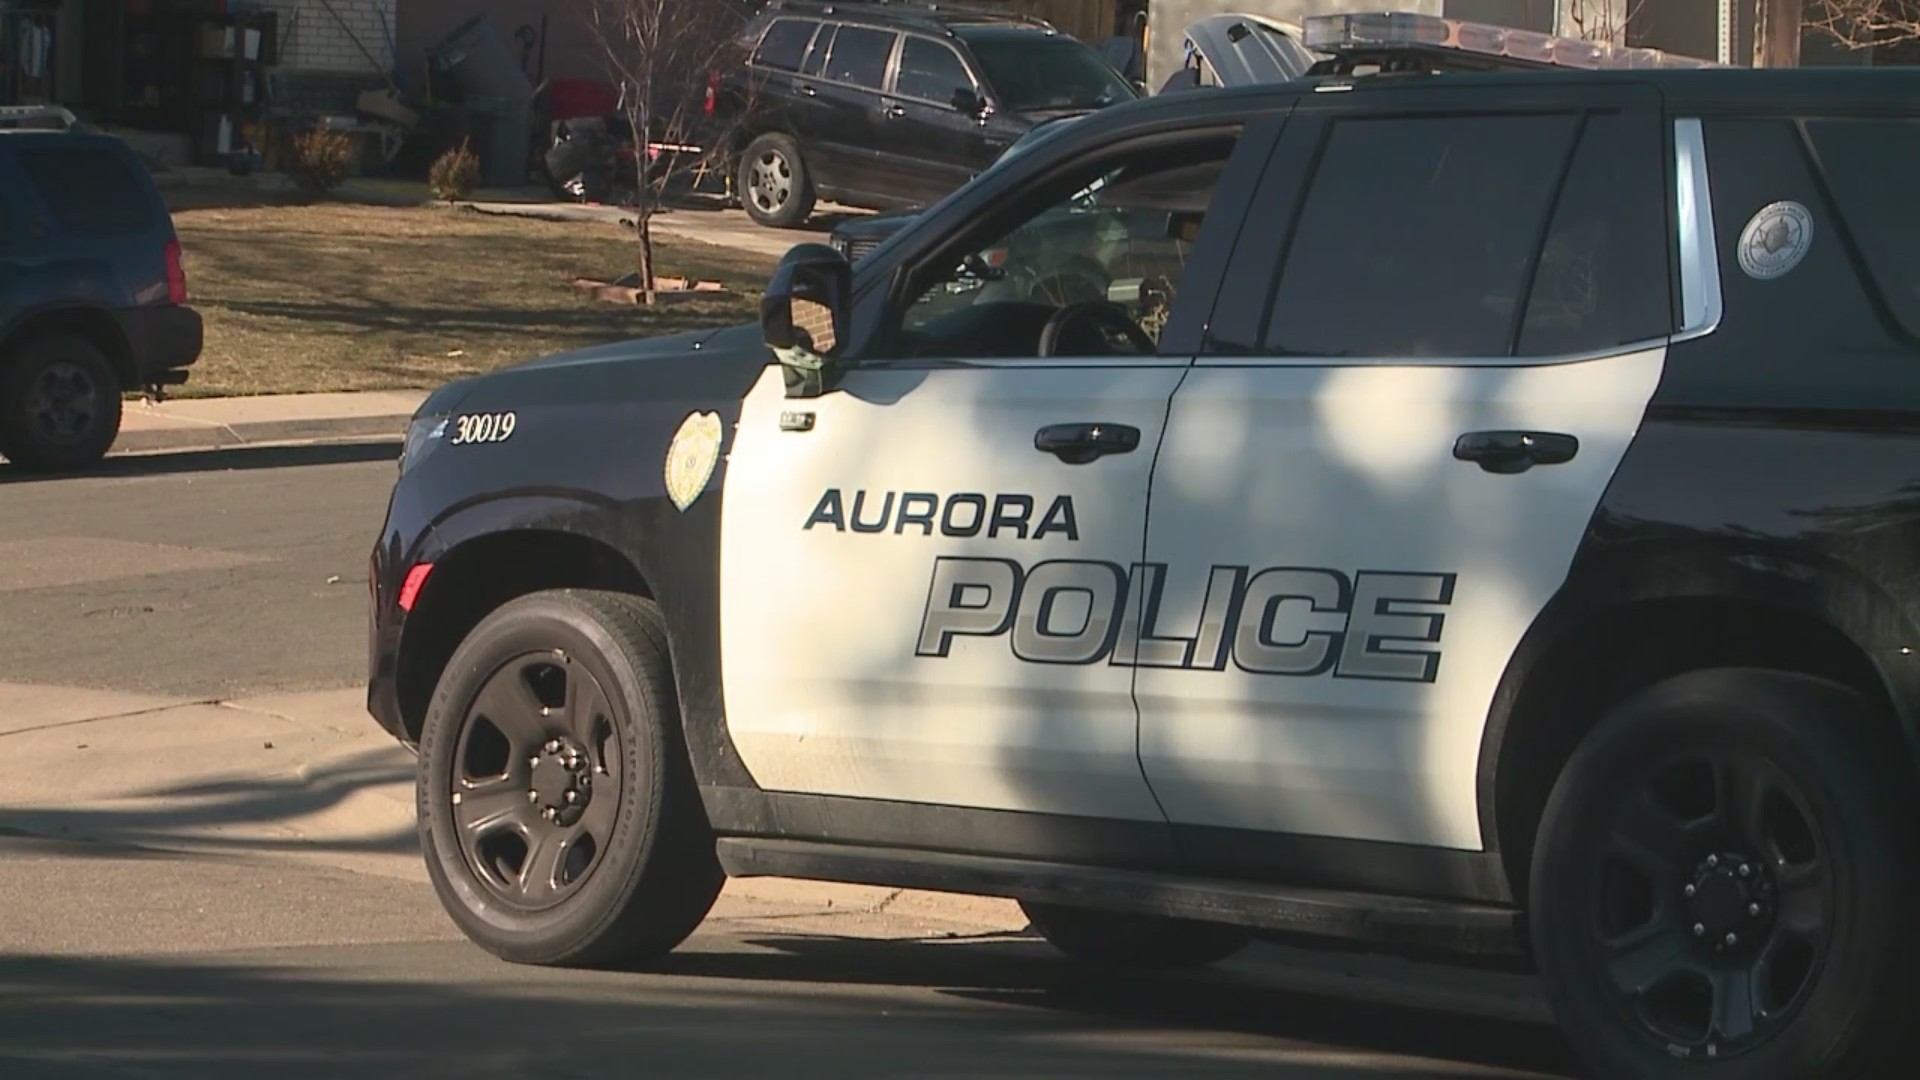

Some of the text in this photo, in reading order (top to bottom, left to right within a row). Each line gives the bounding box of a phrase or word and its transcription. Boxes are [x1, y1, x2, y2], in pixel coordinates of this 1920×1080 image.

[453, 411, 516, 445] 30019
[802, 488, 1080, 541] AURORA
[915, 556, 1458, 683] POLICE
